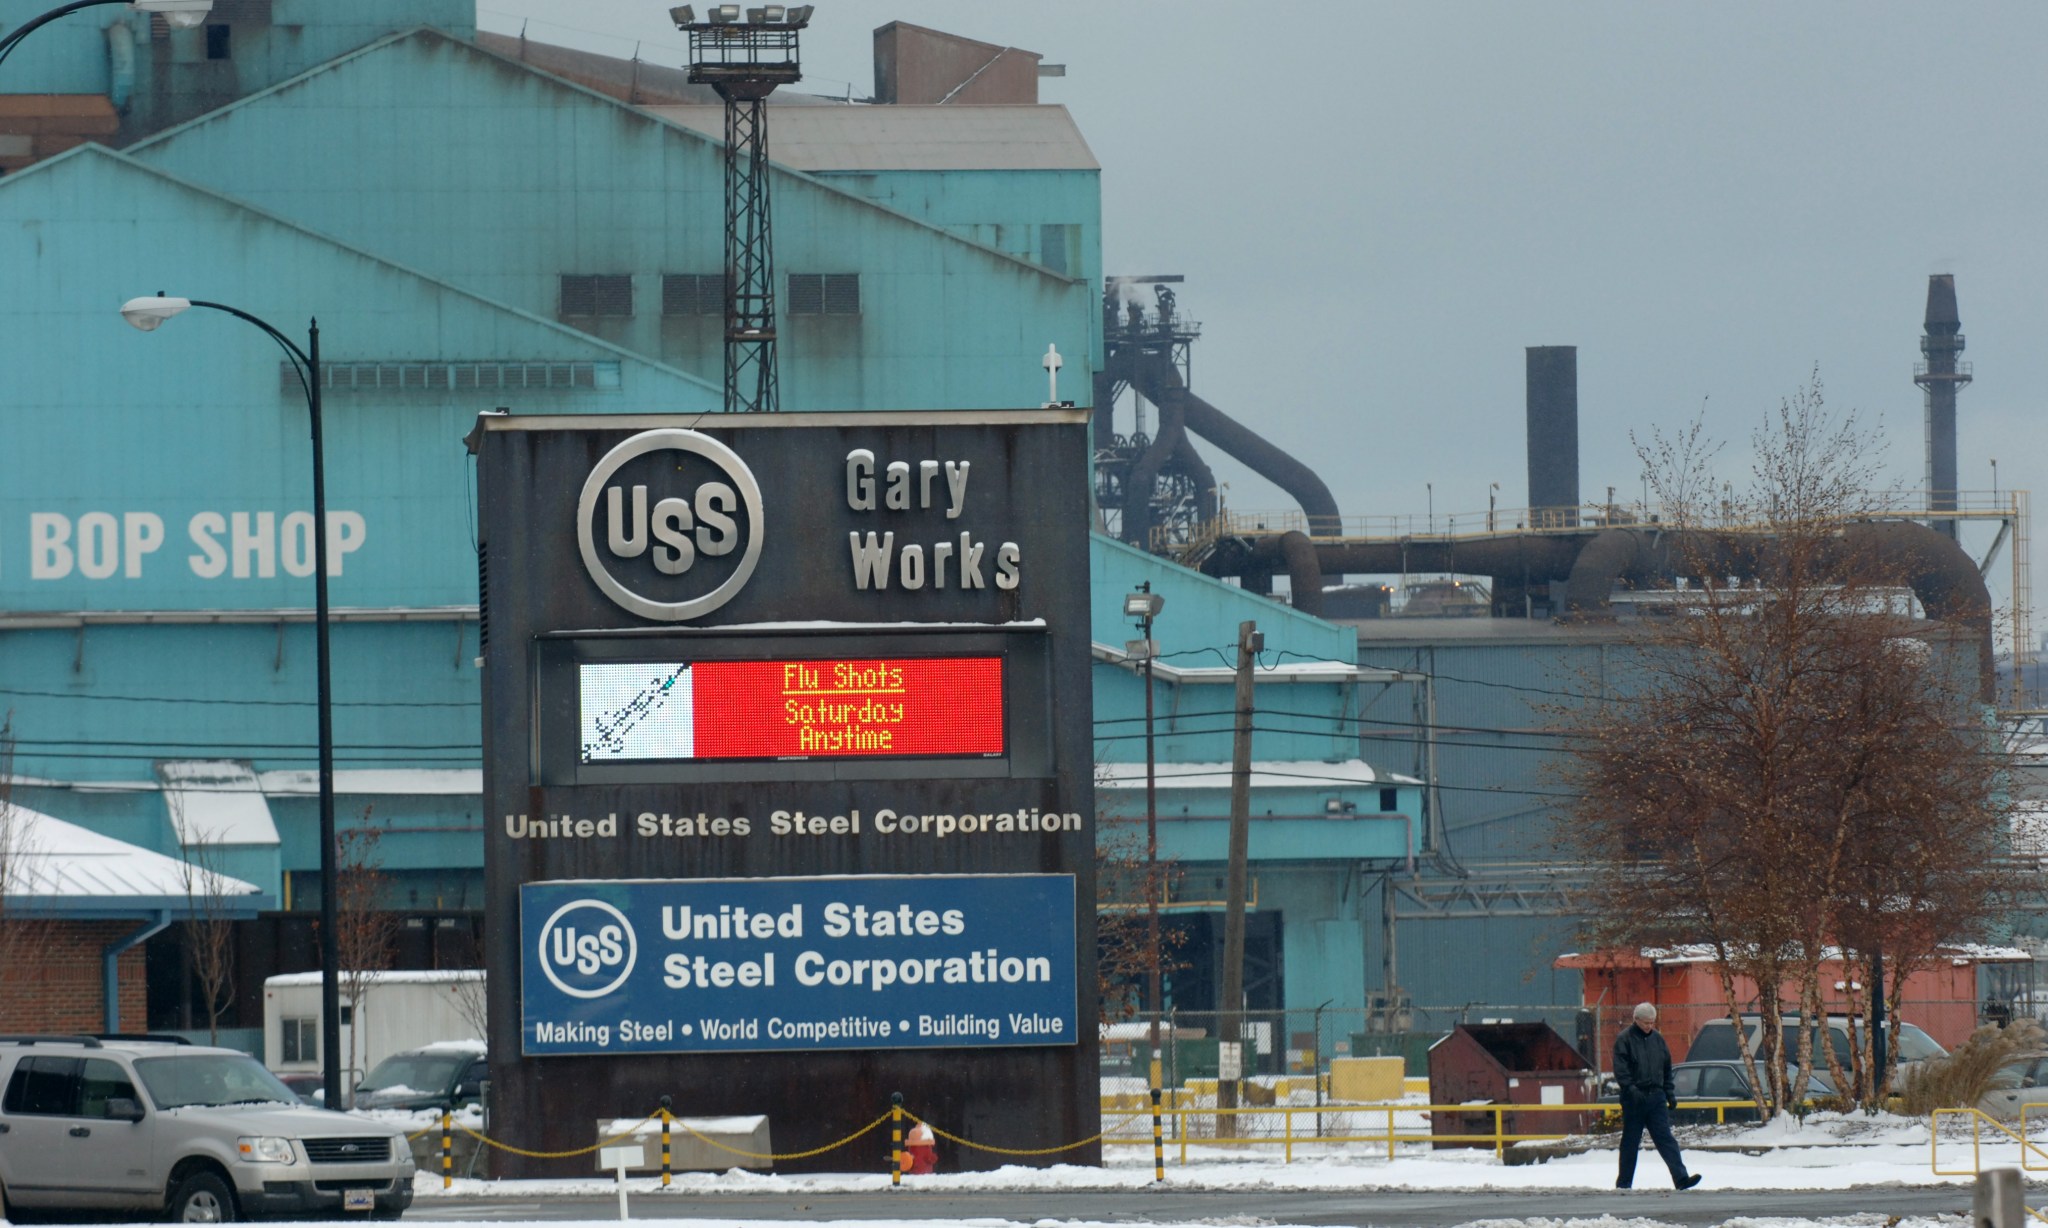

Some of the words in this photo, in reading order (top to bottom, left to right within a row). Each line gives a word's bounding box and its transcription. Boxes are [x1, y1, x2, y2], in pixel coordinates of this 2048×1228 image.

[846, 448, 971, 519] Gary
[30, 511, 165, 580] BOP
[188, 510, 367, 579] SHOP
[607, 482, 739, 575] USS
[850, 531, 1021, 590] Works
[785, 664, 818, 688] Flu
[834, 663, 902, 687] Shots
[785, 698, 903, 723] Saturday
[801, 725, 892, 750] Anytime
[505, 813, 617, 839] United
[637, 812, 751, 837] States
[771, 810, 860, 835] Steel
[875, 809, 1082, 838] Corporation
[662, 904, 803, 940] United
[823, 903, 965, 937] States
[553, 926, 623, 975] USS
[663, 953, 775, 989] Steel
[795, 949, 1051, 991] Corporation
[536, 1021, 610, 1046] Making
[619, 1019, 673, 1042] Steel
[700, 1018, 758, 1040] World
[767, 1016, 891, 1042] Competitive
[918, 1014, 1000, 1039] Building
[1008, 1013, 1063, 1035] Value
